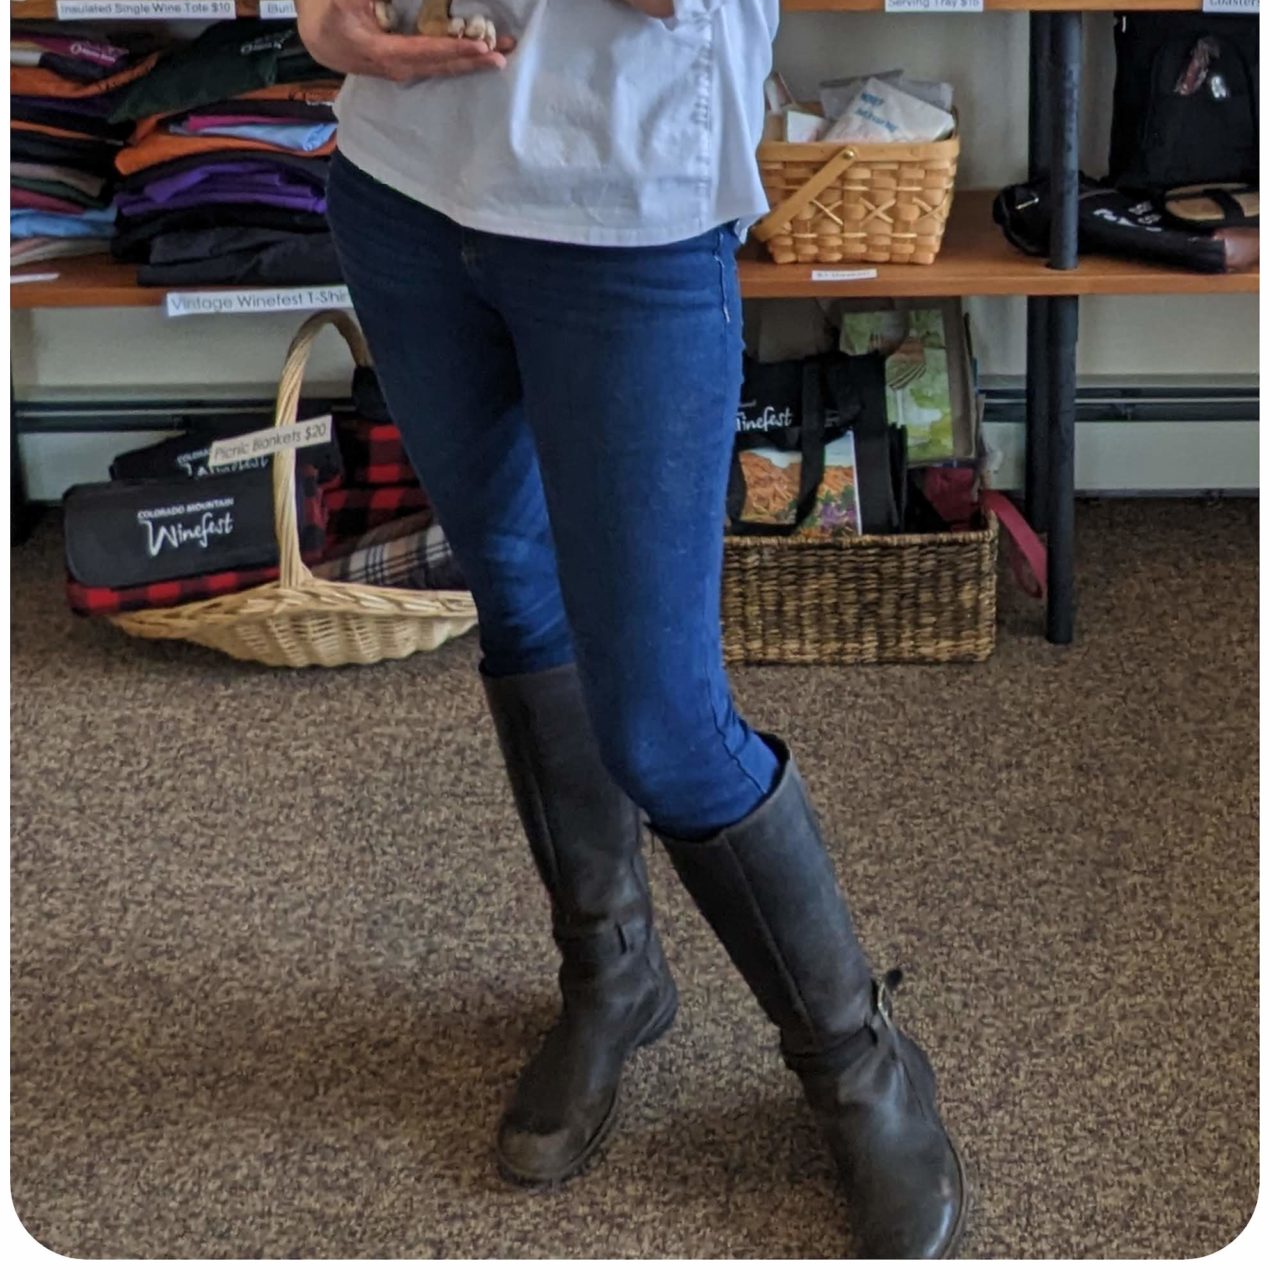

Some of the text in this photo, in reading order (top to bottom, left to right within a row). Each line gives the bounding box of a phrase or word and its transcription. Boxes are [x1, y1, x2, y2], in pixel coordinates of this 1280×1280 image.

[61, 3, 112, 14] Insulated
[114, 2, 150, 15] Single
[152, 2, 182, 13] Wine
[184, 2, 209, 13] Tote
[171, 294, 233, 312] Vintage
[237, 292, 302, 308] Winefest
[214, 423, 327, 460] Picnic Blankets $20
[137, 497, 235, 520] COLORADO MOUNTAIN
[138, 512, 234, 557] Winefest
